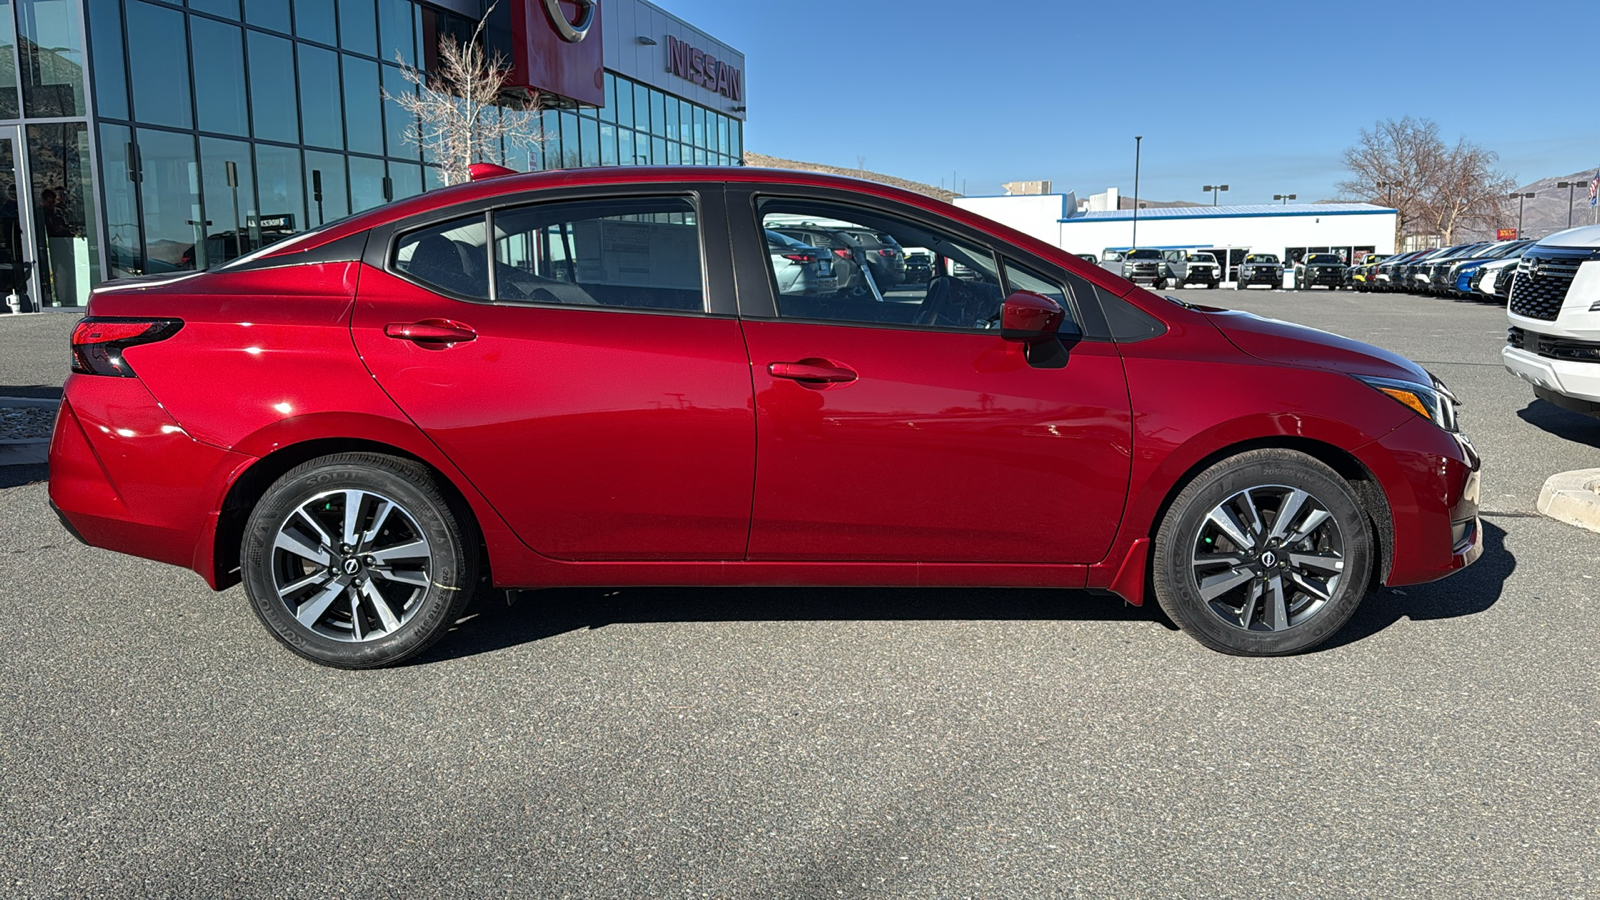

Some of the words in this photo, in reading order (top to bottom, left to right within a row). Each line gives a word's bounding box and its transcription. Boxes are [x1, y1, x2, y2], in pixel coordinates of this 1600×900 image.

[665, 34, 741, 101] NISSAN
[437, 566, 450, 602] 20555
[260, 597, 307, 649] KUMHO
